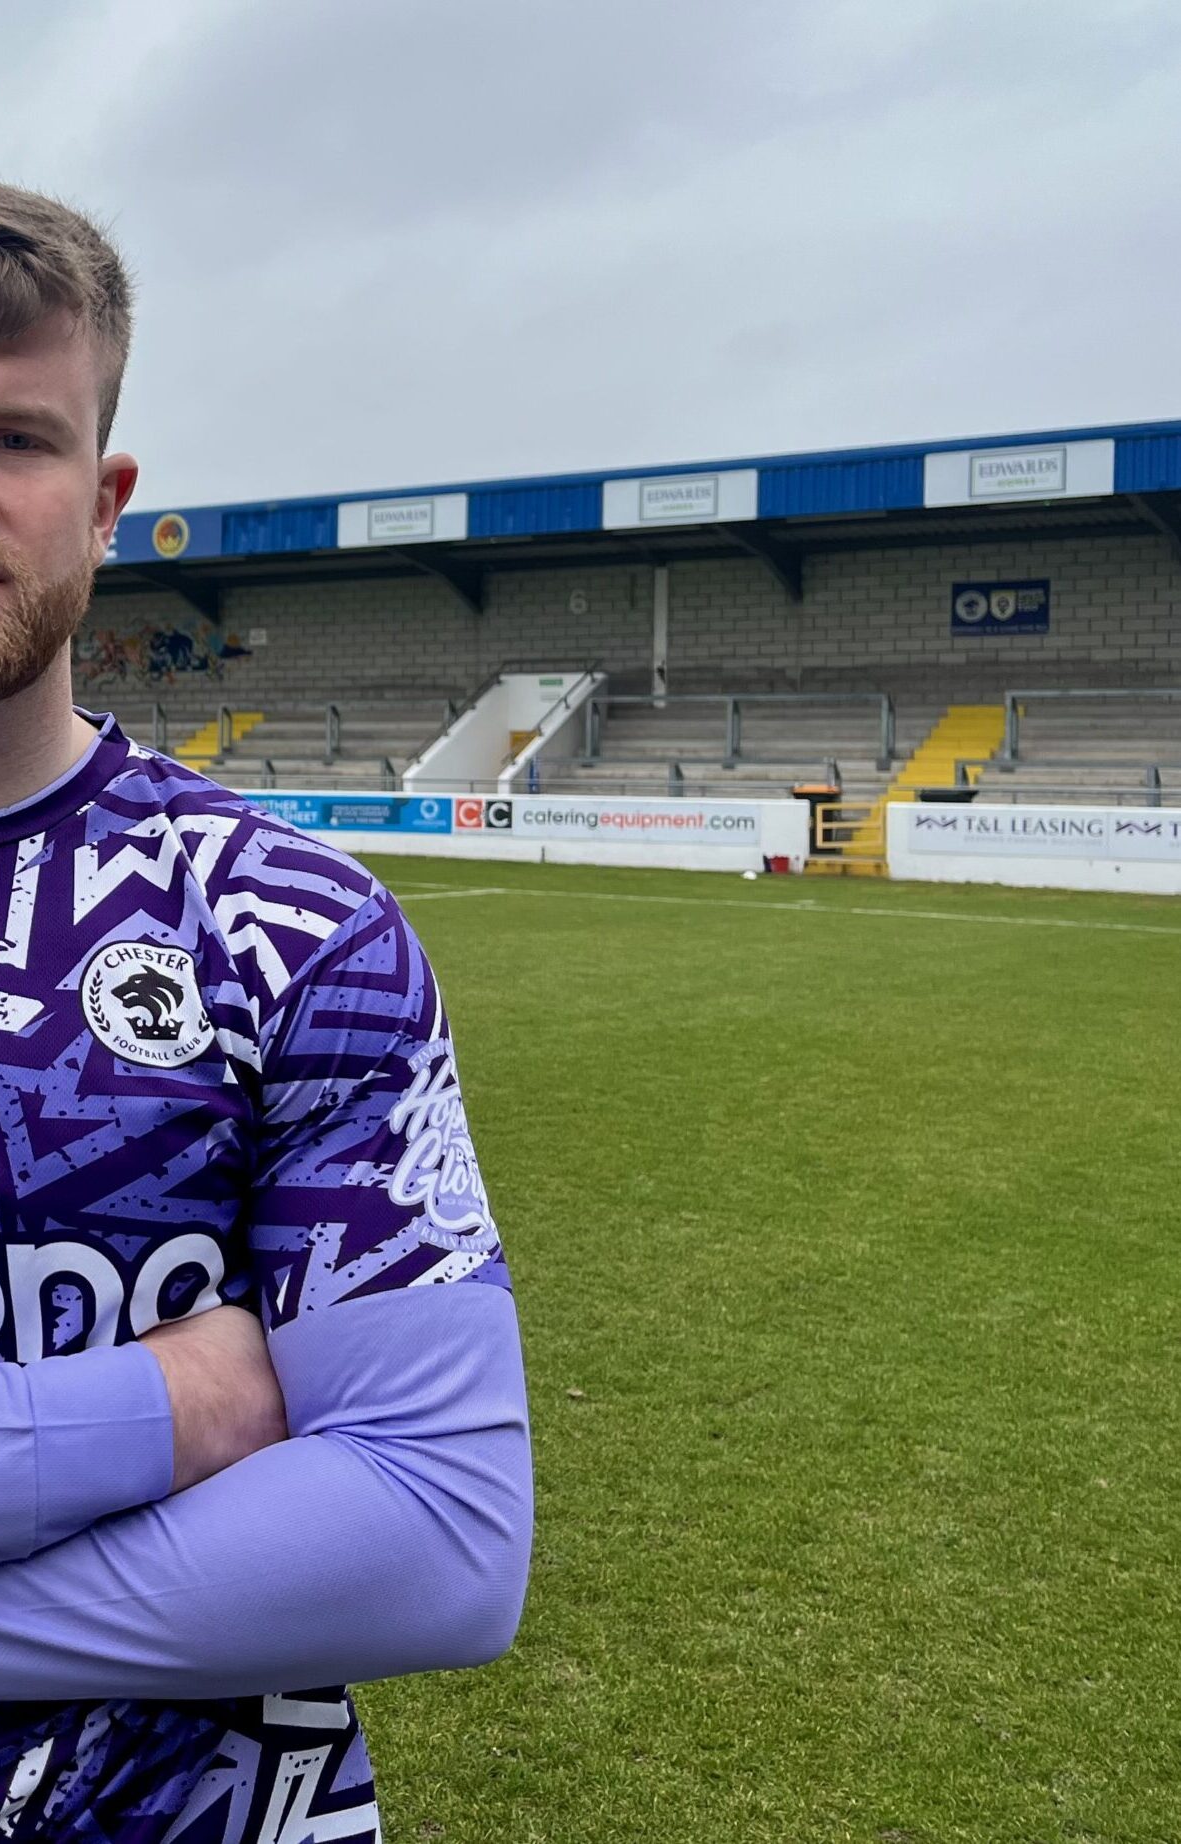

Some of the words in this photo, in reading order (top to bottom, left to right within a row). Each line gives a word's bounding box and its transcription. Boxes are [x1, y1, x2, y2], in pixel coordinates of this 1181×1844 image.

[979, 457, 1058, 478] EDWARDS
[523, 807, 755, 831] cateringequipment.com
[964, 816, 1004, 833] T&L
[1011, 817, 1103, 837] LEASING
[104, 948, 189, 972] CHESTER
[113, 1035, 169, 1061] FOOTBALL
[174, 1037, 201, 1057] CLUB
[390, 1058, 468, 1145] Hop
